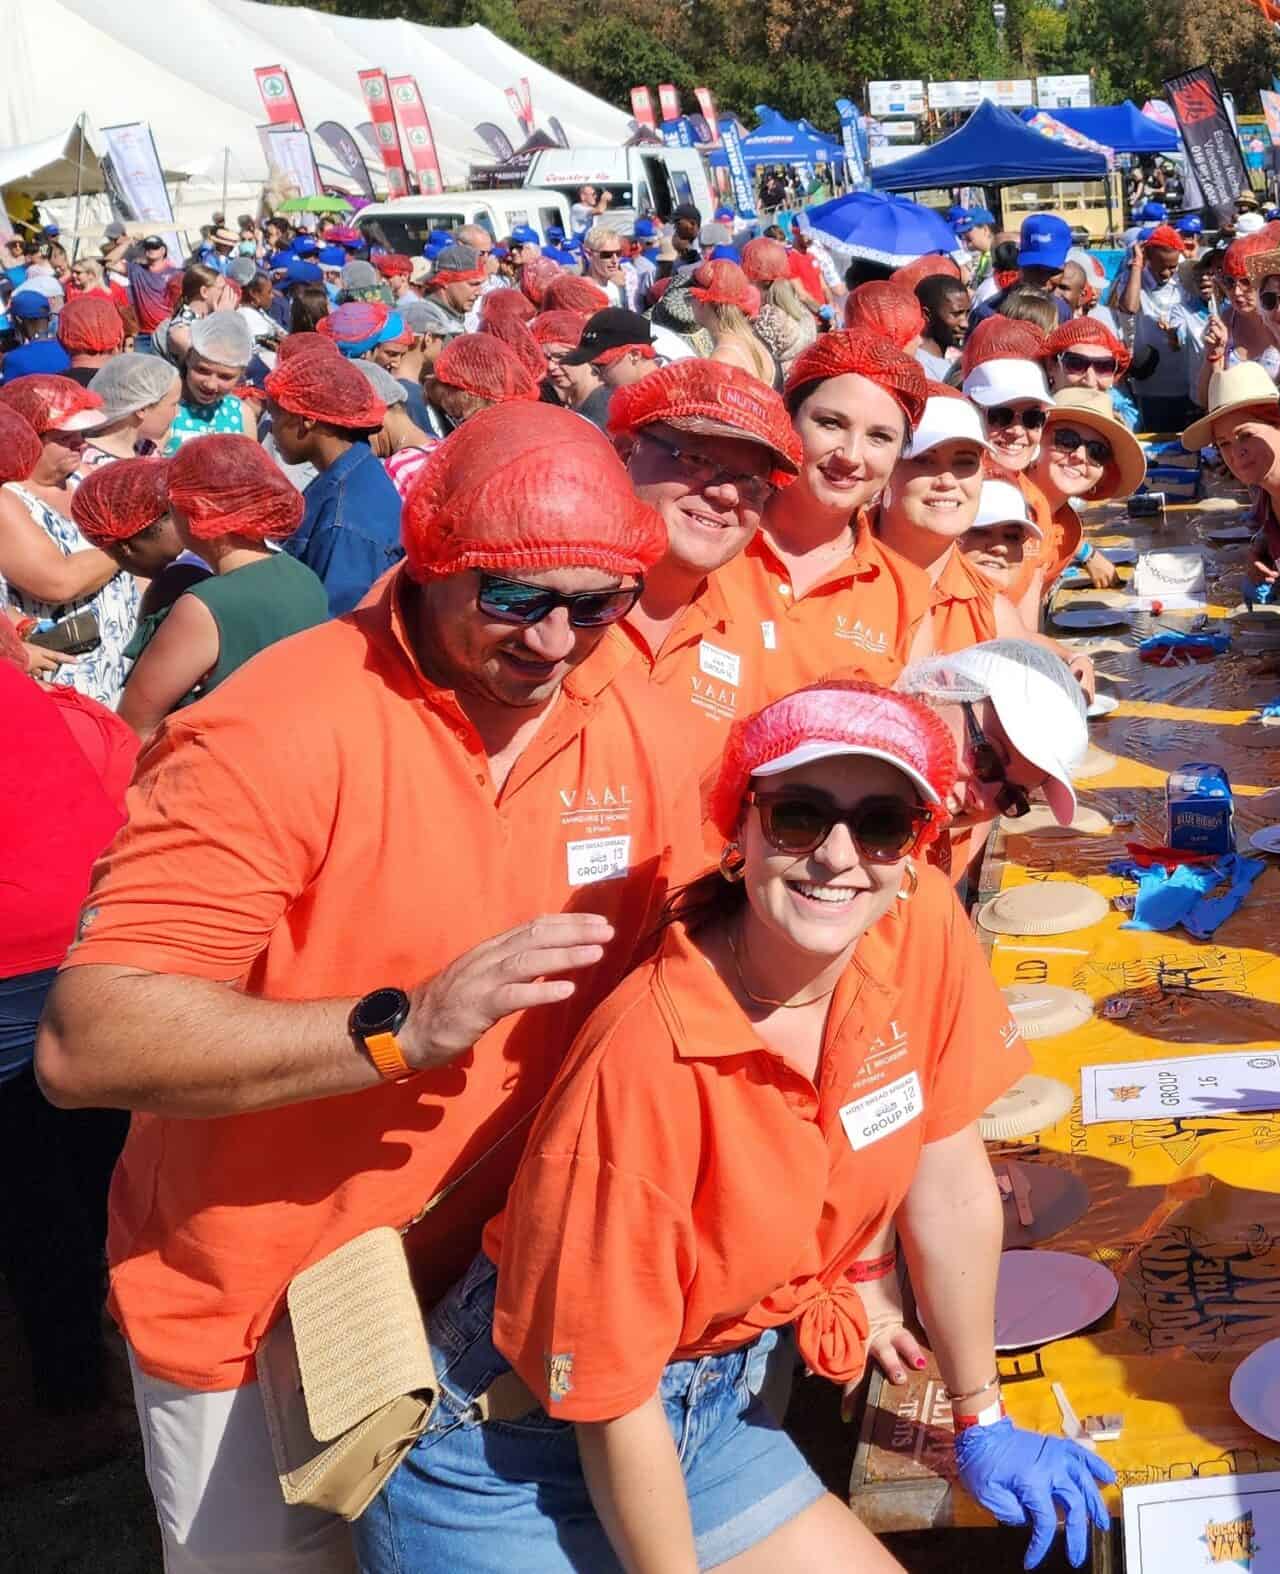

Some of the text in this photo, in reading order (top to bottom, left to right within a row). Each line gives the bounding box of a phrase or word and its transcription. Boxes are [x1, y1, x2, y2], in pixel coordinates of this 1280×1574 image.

[559, 784, 632, 808] VAAL
[577, 863, 609, 877] GROUP
[1158, 1070, 1180, 1107] GROUP
[1197, 1074, 1219, 1088] 16
[862, 1101, 915, 1137] GROUP 16
